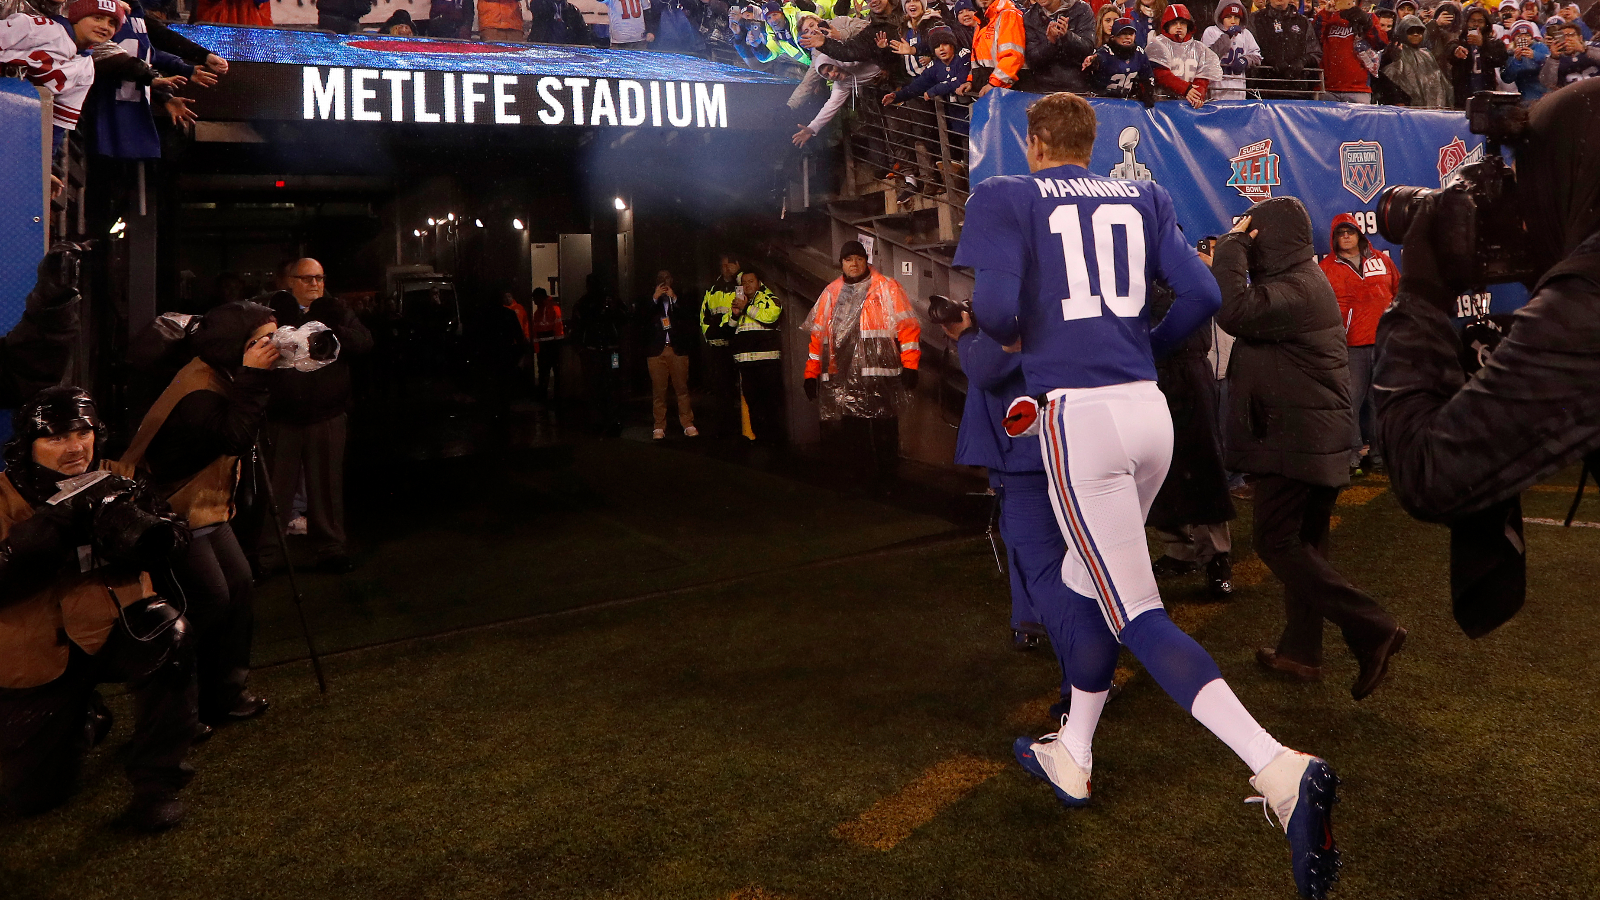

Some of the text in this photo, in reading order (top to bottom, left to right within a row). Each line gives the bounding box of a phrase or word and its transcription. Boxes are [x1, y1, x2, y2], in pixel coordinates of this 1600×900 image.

[302, 66, 728, 128] METLIFE STADIUM
[1242, 142, 1266, 155] SUPER
[1227, 155, 1277, 185] XLII
[1348, 165, 1377, 189] XXV
[1034, 178, 1140, 198] MANNING
[1048, 203, 1147, 321] 10
